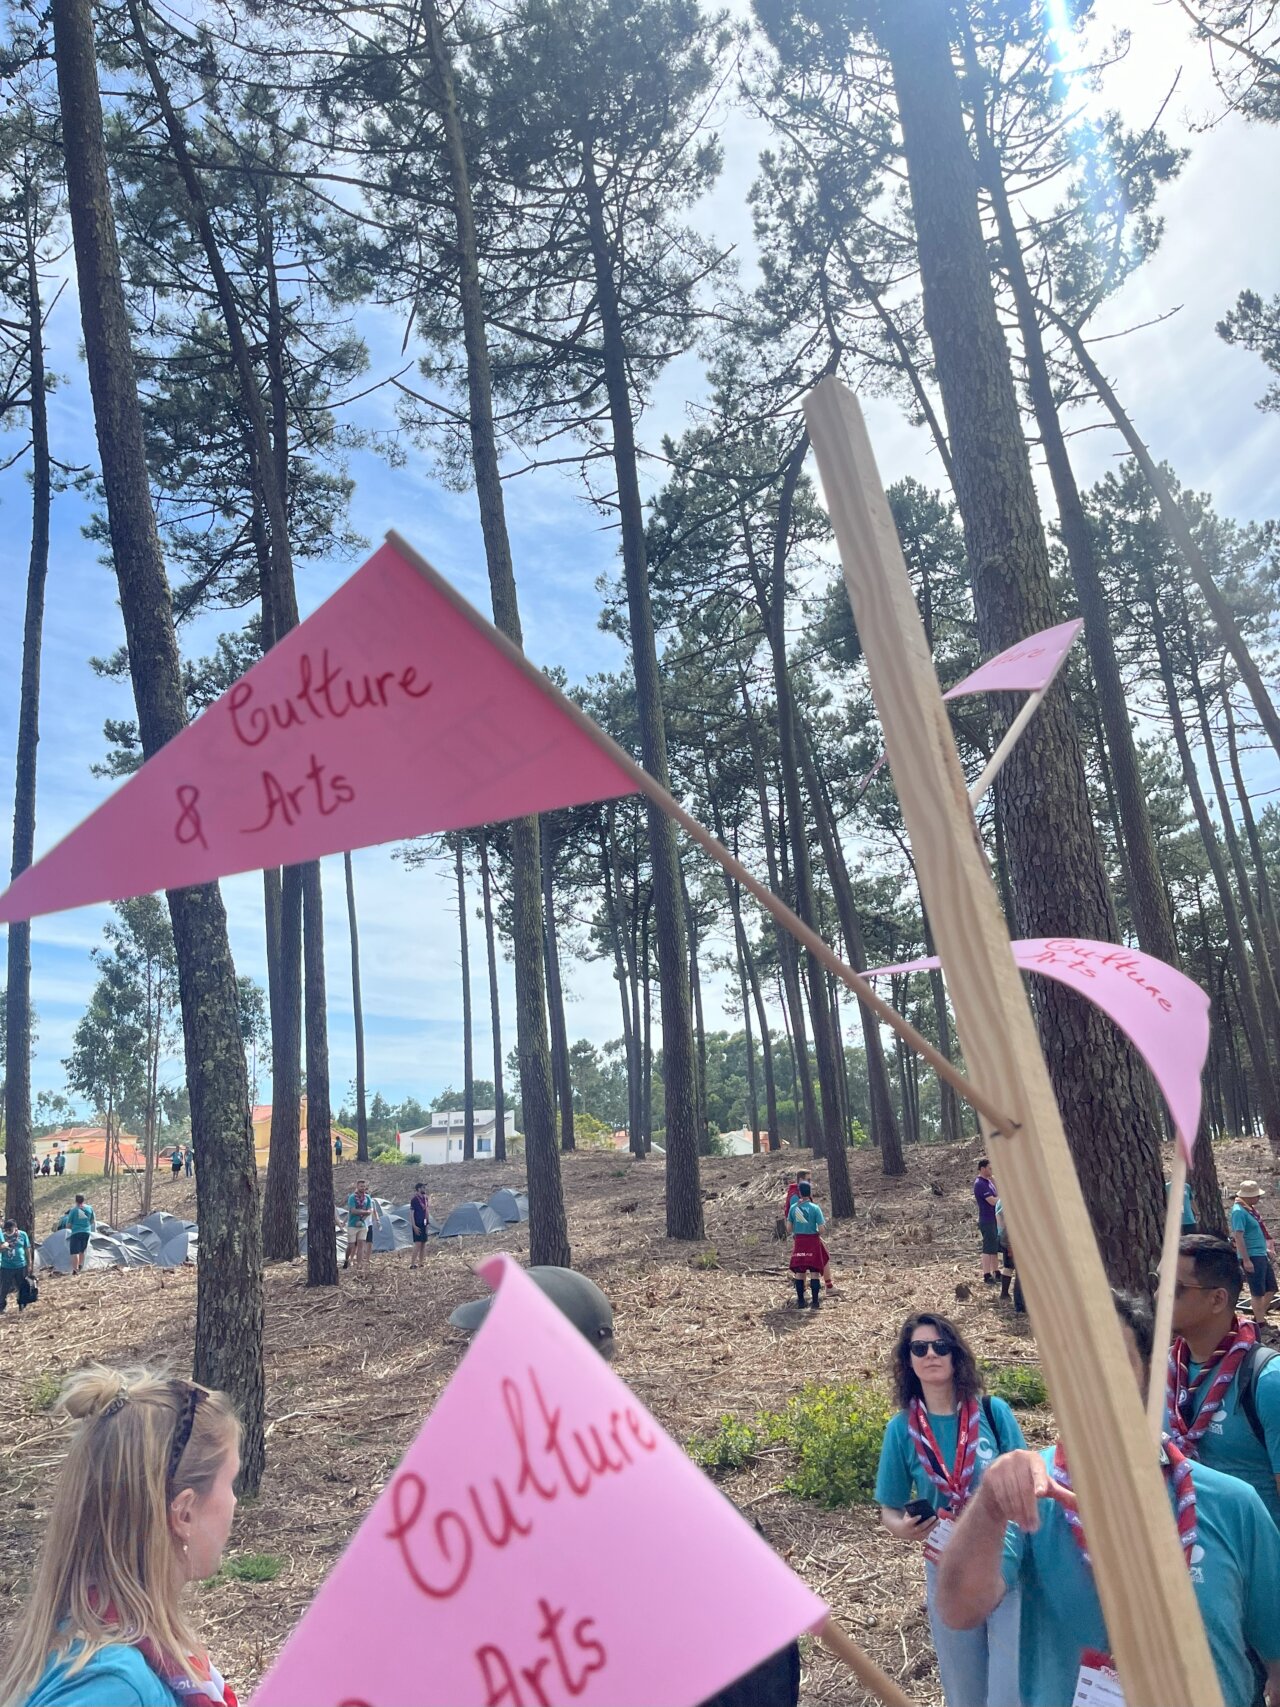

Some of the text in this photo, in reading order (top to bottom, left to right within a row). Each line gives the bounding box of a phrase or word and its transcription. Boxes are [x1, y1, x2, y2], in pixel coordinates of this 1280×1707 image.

[228, 648, 432, 747] Culture
[174, 753, 356, 851] & Arts
[1016, 951, 1097, 978] Arts
[1044, 939, 1172, 1012] Culture
[384, 1364, 658, 1600] Culture
[475, 1596, 608, 1707] Arts
